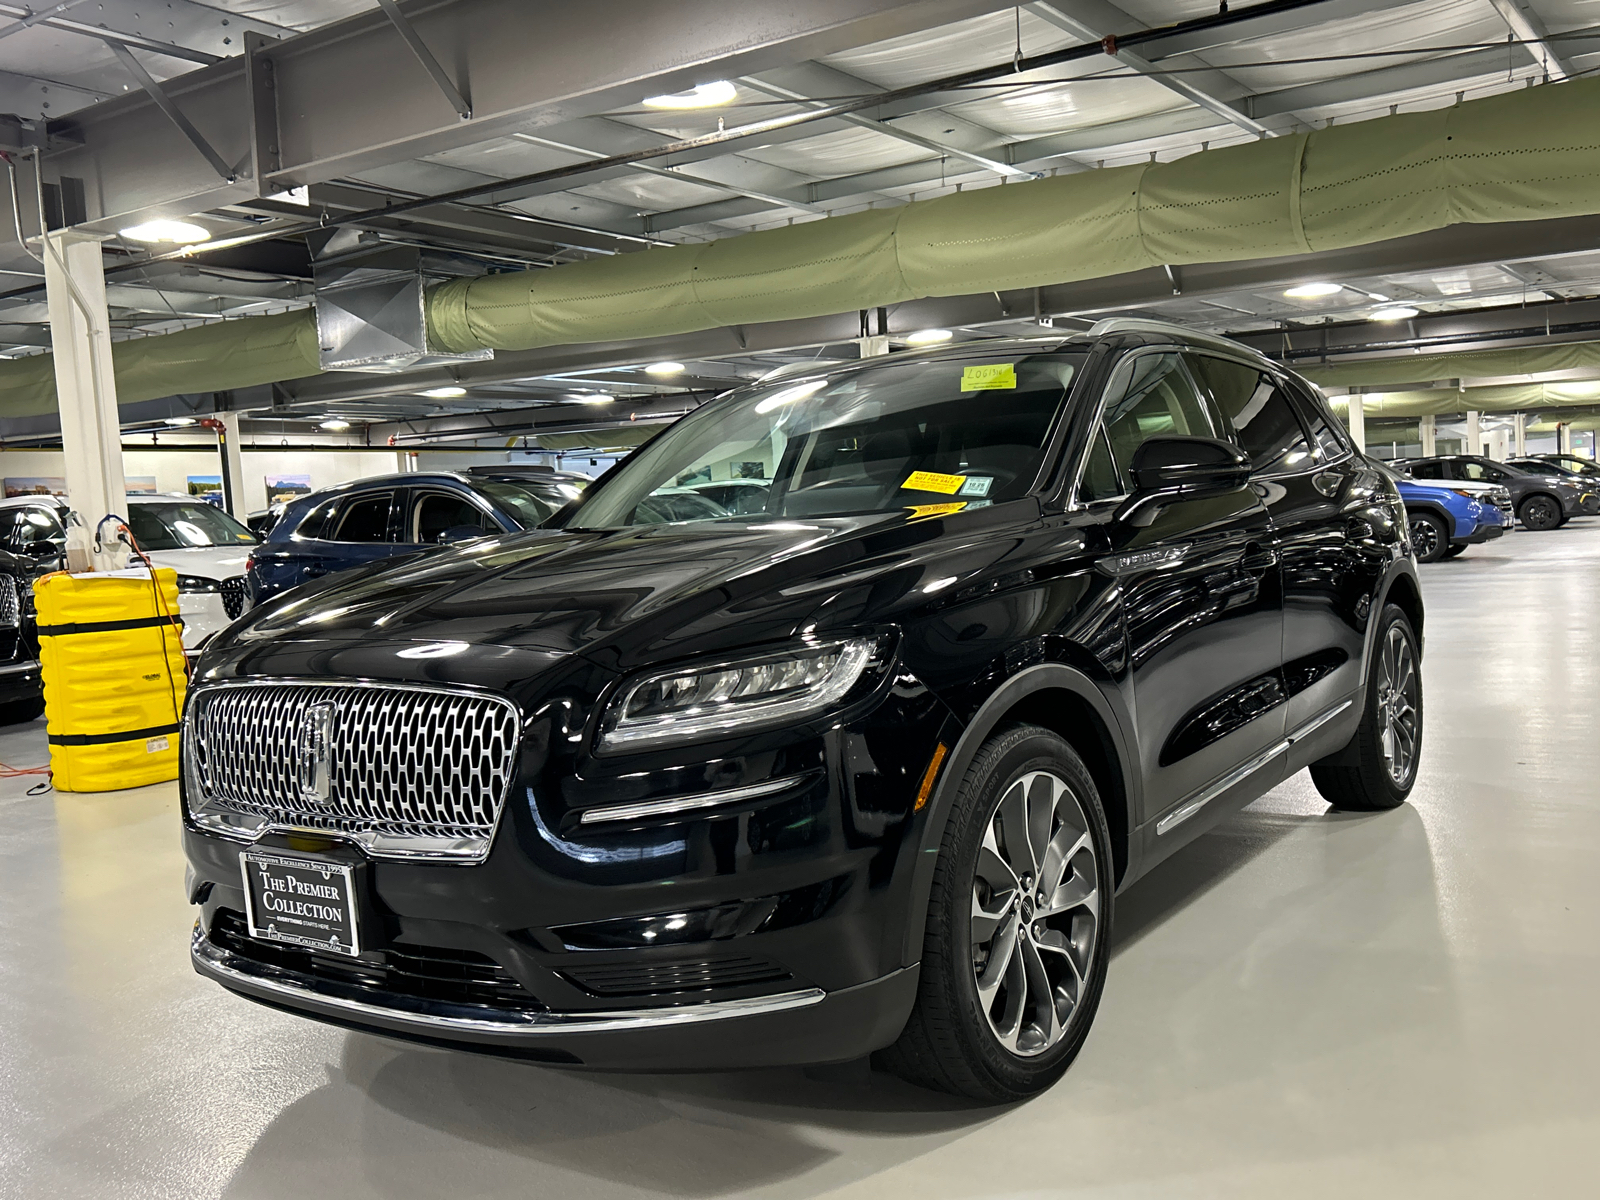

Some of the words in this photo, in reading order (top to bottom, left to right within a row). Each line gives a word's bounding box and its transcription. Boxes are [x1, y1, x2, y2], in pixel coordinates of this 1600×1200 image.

[286, 875, 340, 900] PREMIER
[262, 891, 342, 922] COLLECTION
[276, 915, 303, 925] EVERYTHING
